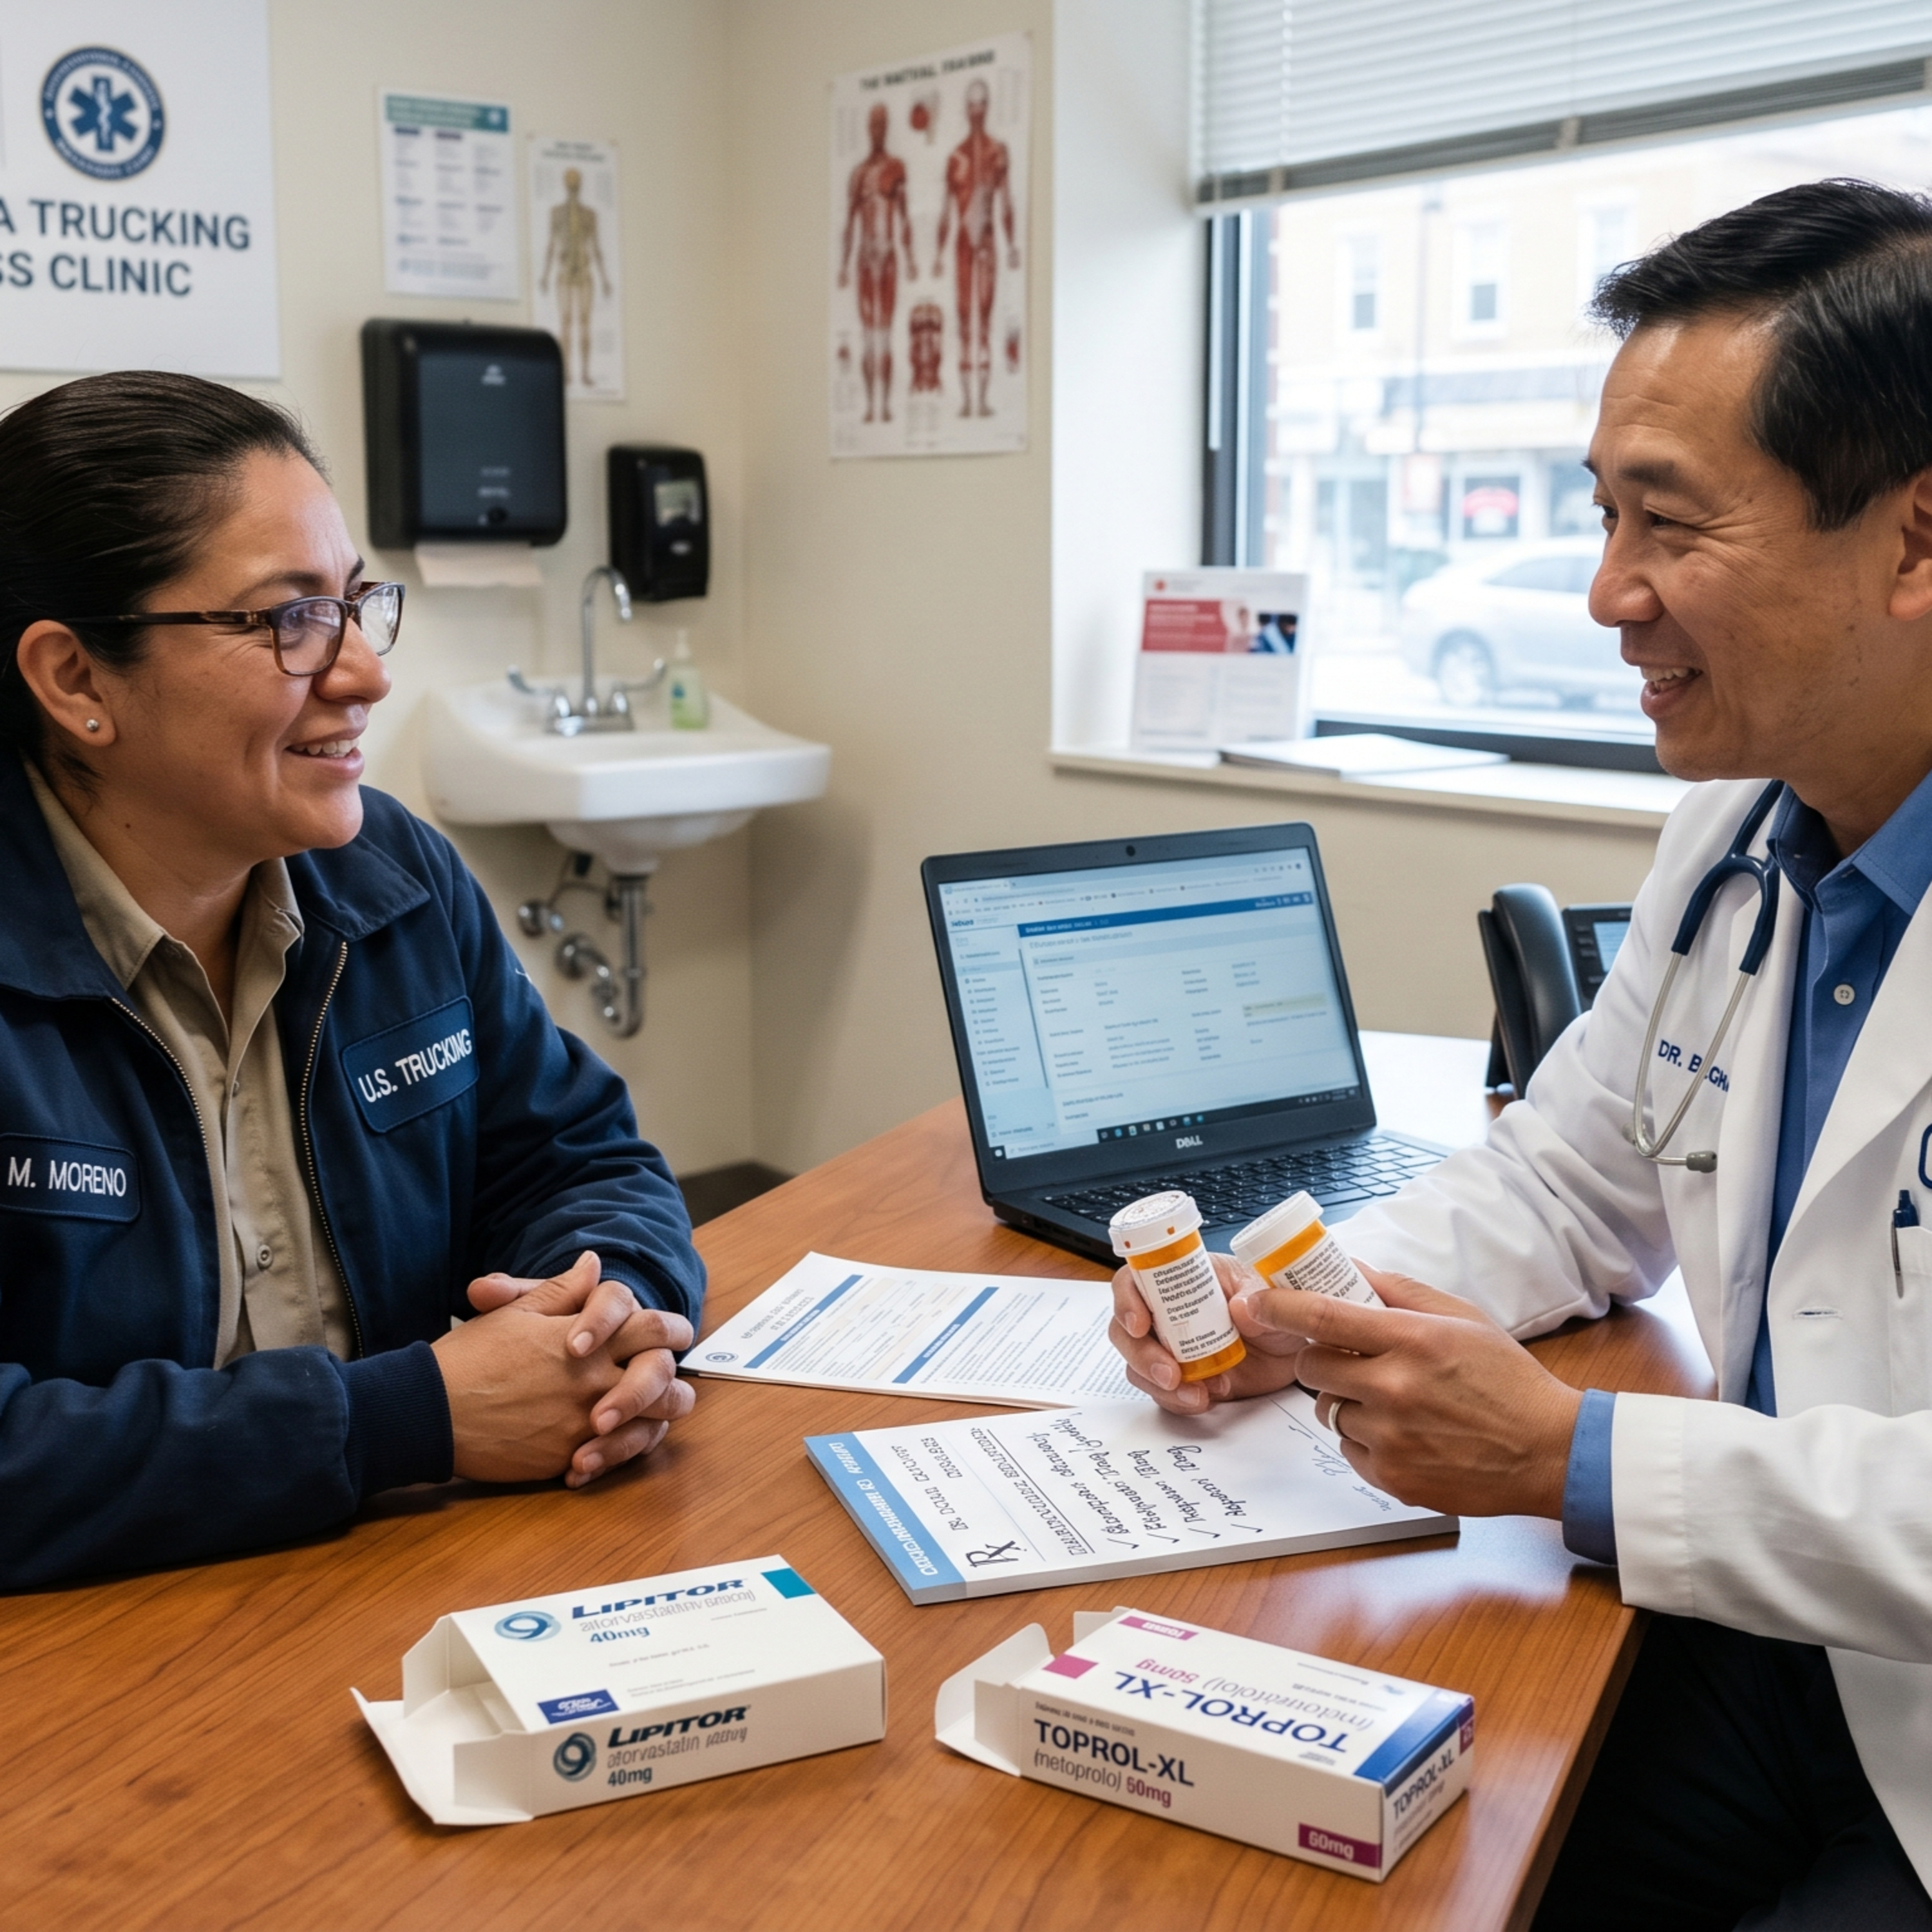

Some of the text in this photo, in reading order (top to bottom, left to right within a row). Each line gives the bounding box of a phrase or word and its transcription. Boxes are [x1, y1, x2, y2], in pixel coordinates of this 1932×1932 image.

[30, 200, 251, 251] TRUCKING
[0, 251, 191, 297] S CLINIC
[358, 1028, 472, 1103] U.S. TRUCKING
[1658, 1039, 1681, 1067] DR.
[8, 1157, 126, 1197] M. MORENO
[573, 1579, 744, 1619] LIPITOR
[607, 1707, 747, 1748] LIPITOR
[1114, 1671, 1348, 1752] TOPROL-XL
[1034, 1718, 1194, 1786] TOPROL-XL
[607, 1767, 652, 1786] 40mg
